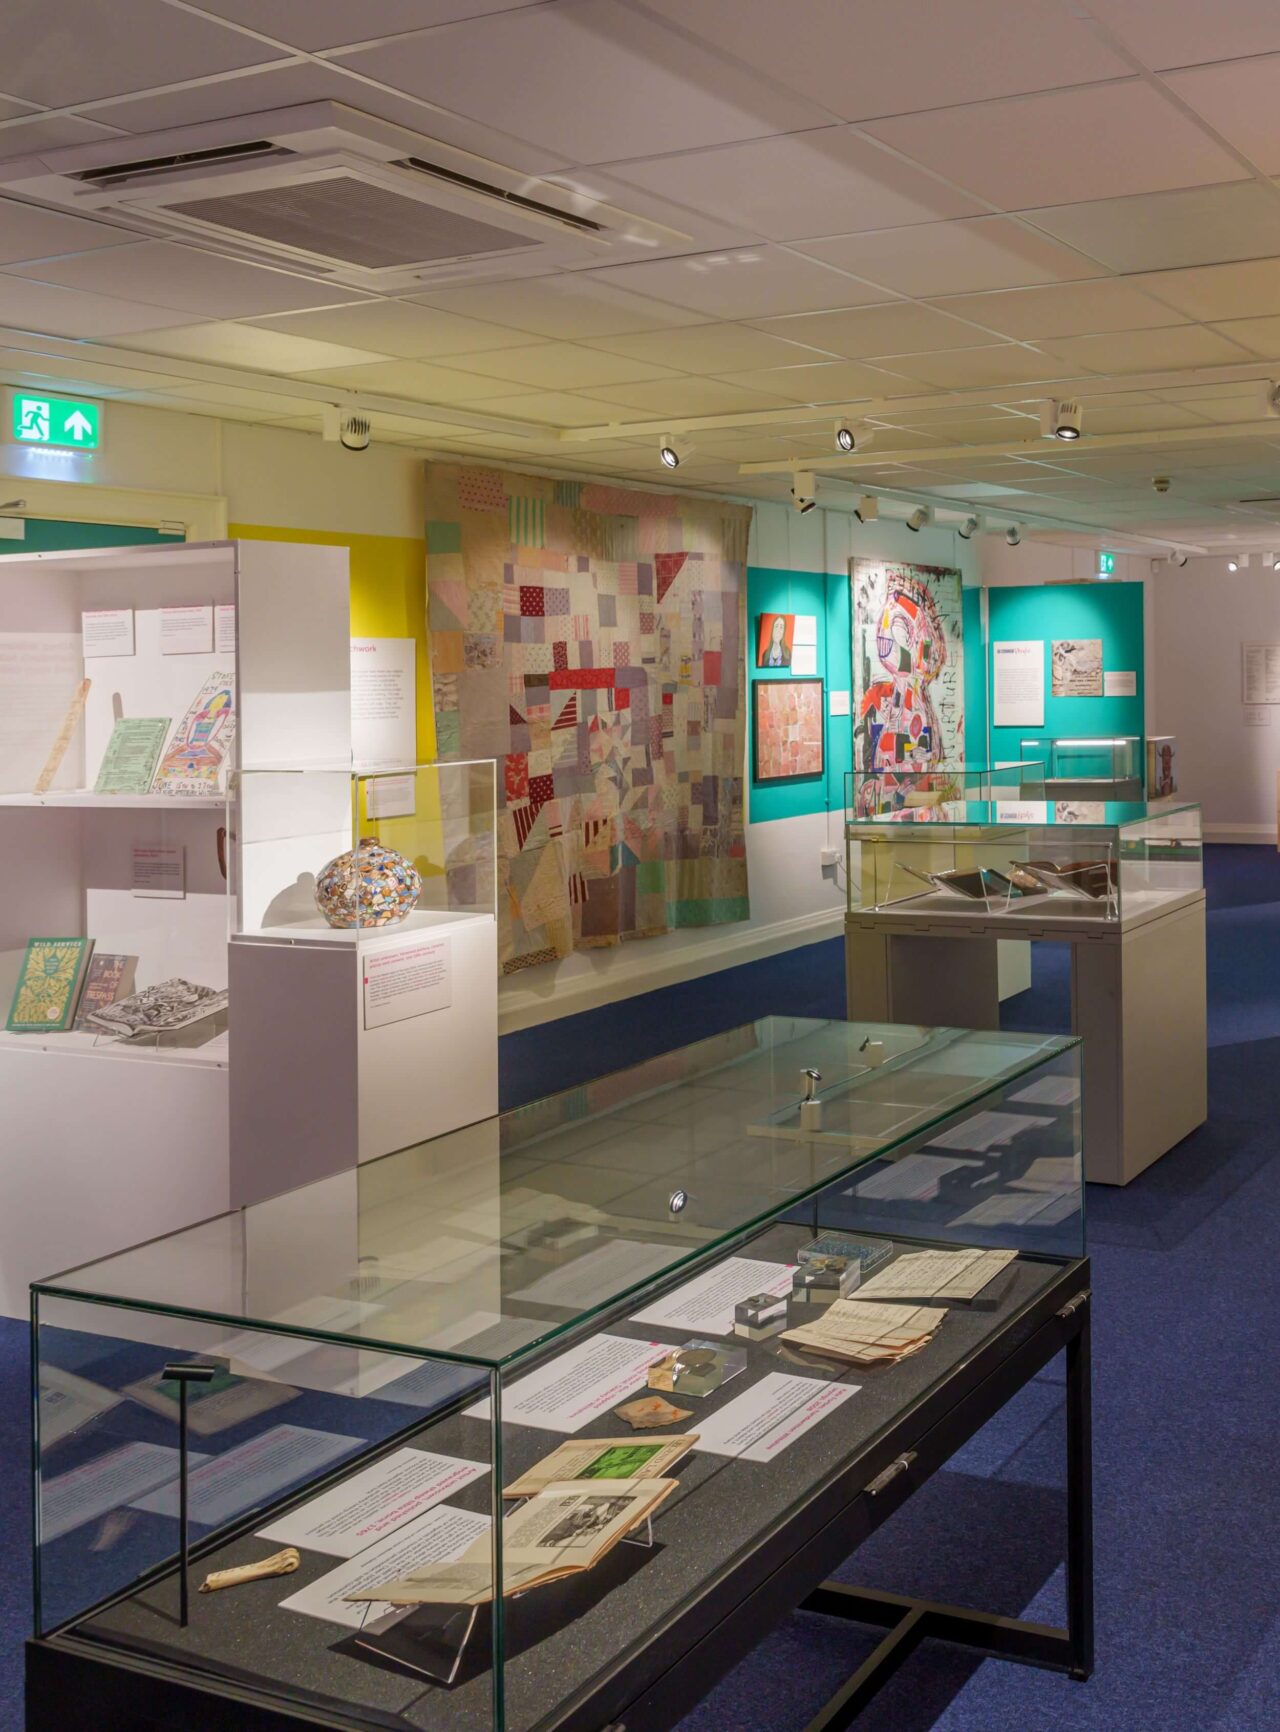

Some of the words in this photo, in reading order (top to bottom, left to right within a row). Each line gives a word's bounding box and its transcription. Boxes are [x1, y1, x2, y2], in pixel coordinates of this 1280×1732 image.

[433, 1466, 470, 1486] engraved
[411, 1486, 438, 1500] sheep
[387, 1501, 425, 1521] polished
